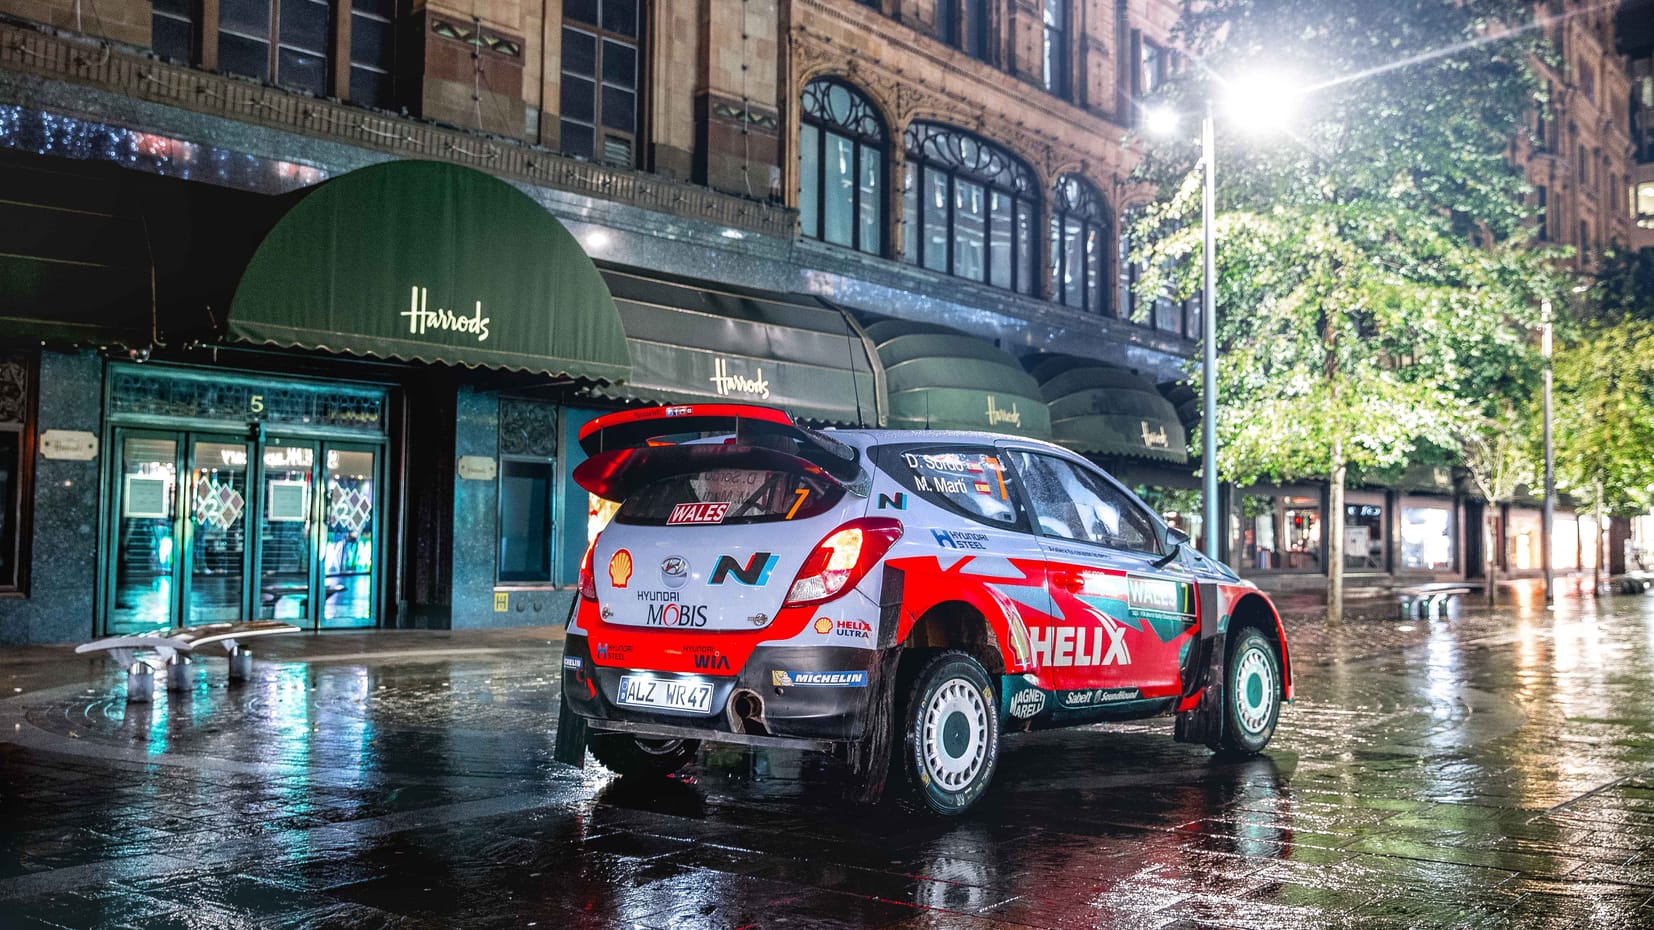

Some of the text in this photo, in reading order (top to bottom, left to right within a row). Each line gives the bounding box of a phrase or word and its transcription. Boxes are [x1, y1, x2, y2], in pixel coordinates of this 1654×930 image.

[400, 286, 490, 341] Harrods
[709, 358, 770, 399] Harrods
[251, 395, 264, 413] 5
[904, 453, 923, 469] D.
[914, 475, 932, 492] M.
[207, 499, 219, 516] 2
[784, 488, 810, 520] 7
[877, 492, 908, 511] N
[341, 502, 350, 519] 2
[671, 504, 728, 523] WALES
[951, 531, 989, 542] HYUNDAI
[957, 540, 987, 550] STEEL
[706, 552, 781, 587] N
[637, 590, 680, 602] HYUNDAI
[646, 603, 708, 628] MOBIS
[836, 619, 872, 631] HELIX
[836, 629, 869, 639] ULTRA
[1029, 624, 1132, 667] HELIX
[795, 674, 863, 683] MICHELIN
[627, 681, 657, 703] ALZ
